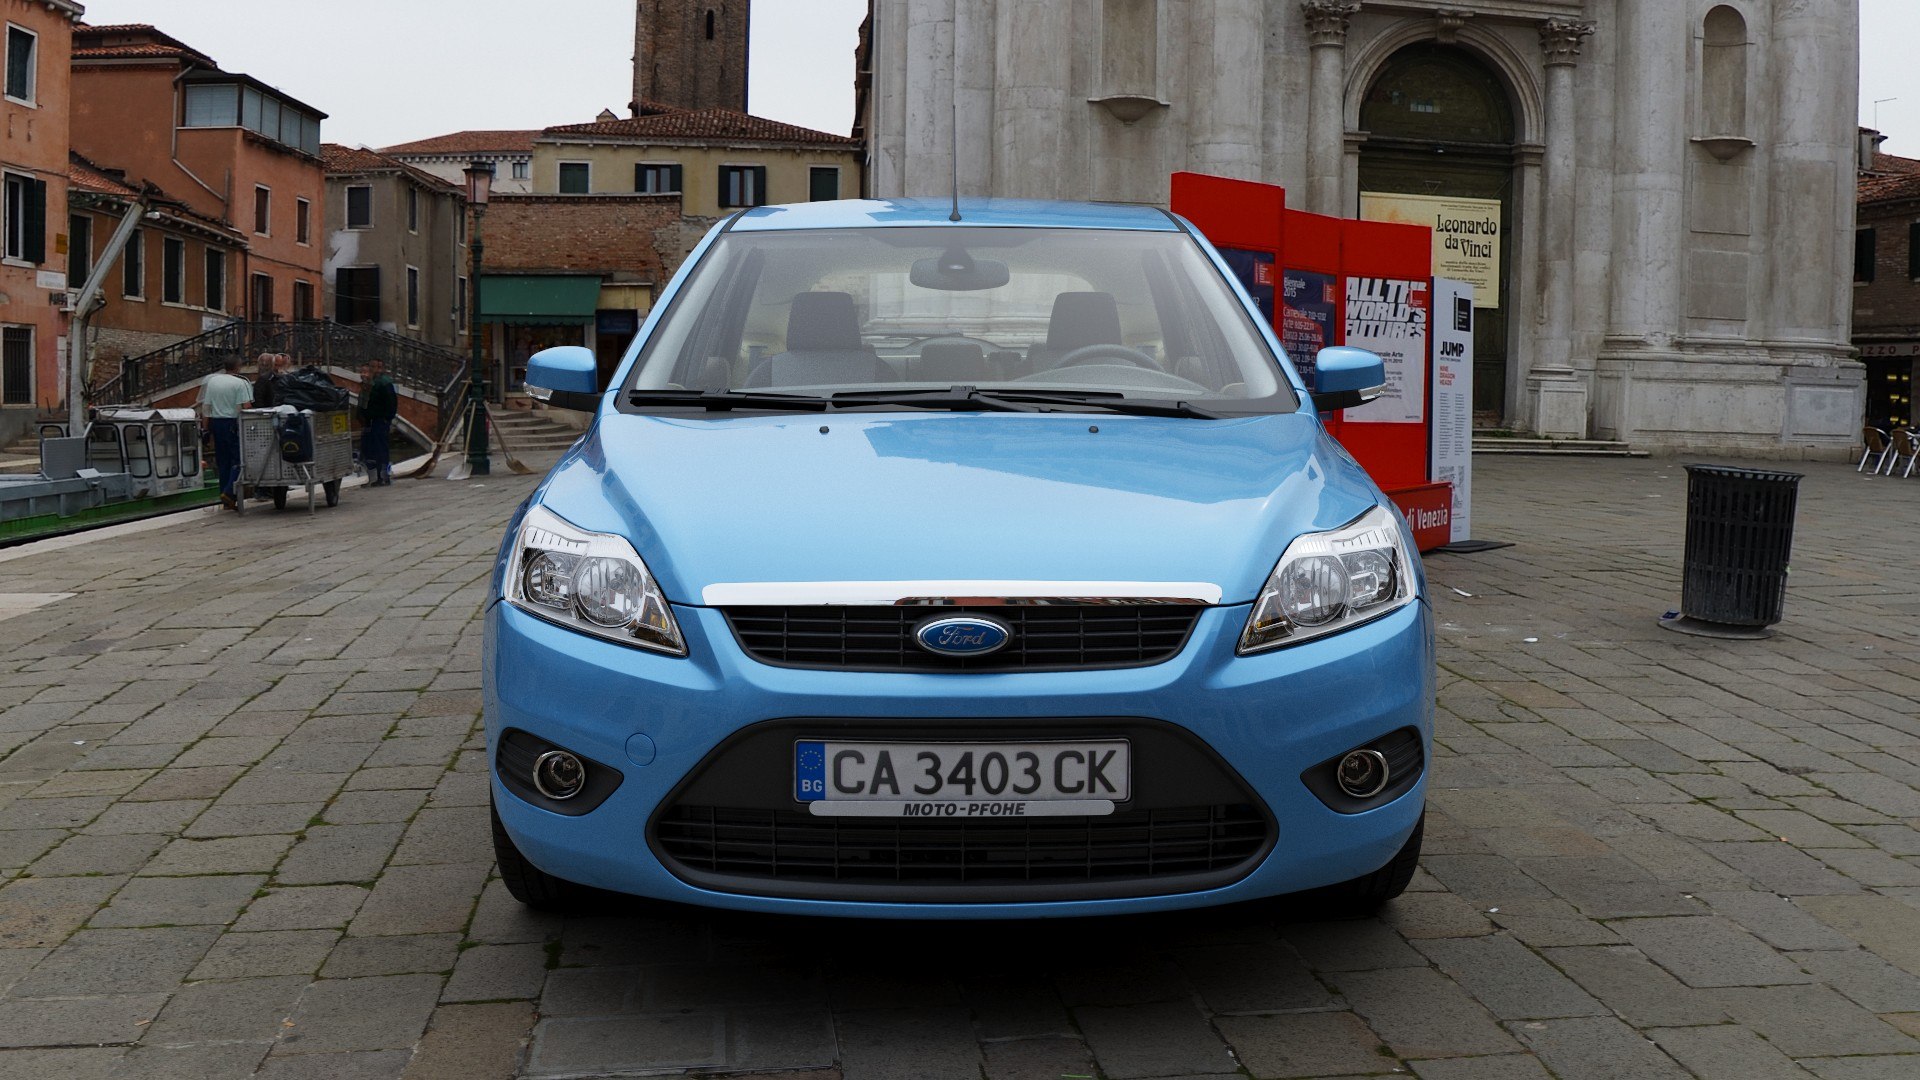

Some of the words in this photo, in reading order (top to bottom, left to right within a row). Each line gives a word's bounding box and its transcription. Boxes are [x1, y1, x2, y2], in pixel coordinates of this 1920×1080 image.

[1436, 214, 1497, 235] Leonardo
[1445, 234, 1458, 249] da
[1460, 238, 1492, 258] Vinci
[1284, 276, 1306, 289] Biennale
[1346, 320, 1426, 339] FUTURES
[1440, 341, 1464, 357] JUMP
[1417, 503, 1448, 530] Venezia
[939, 625, 987, 645] Ford
[833, 750, 900, 795] CA
[914, 751, 1041, 795] 3403
[1054, 750, 1117, 794] CK
[802, 779, 823, 792] BG
[903, 802, 1026, 816] MOTO-PFOHE
